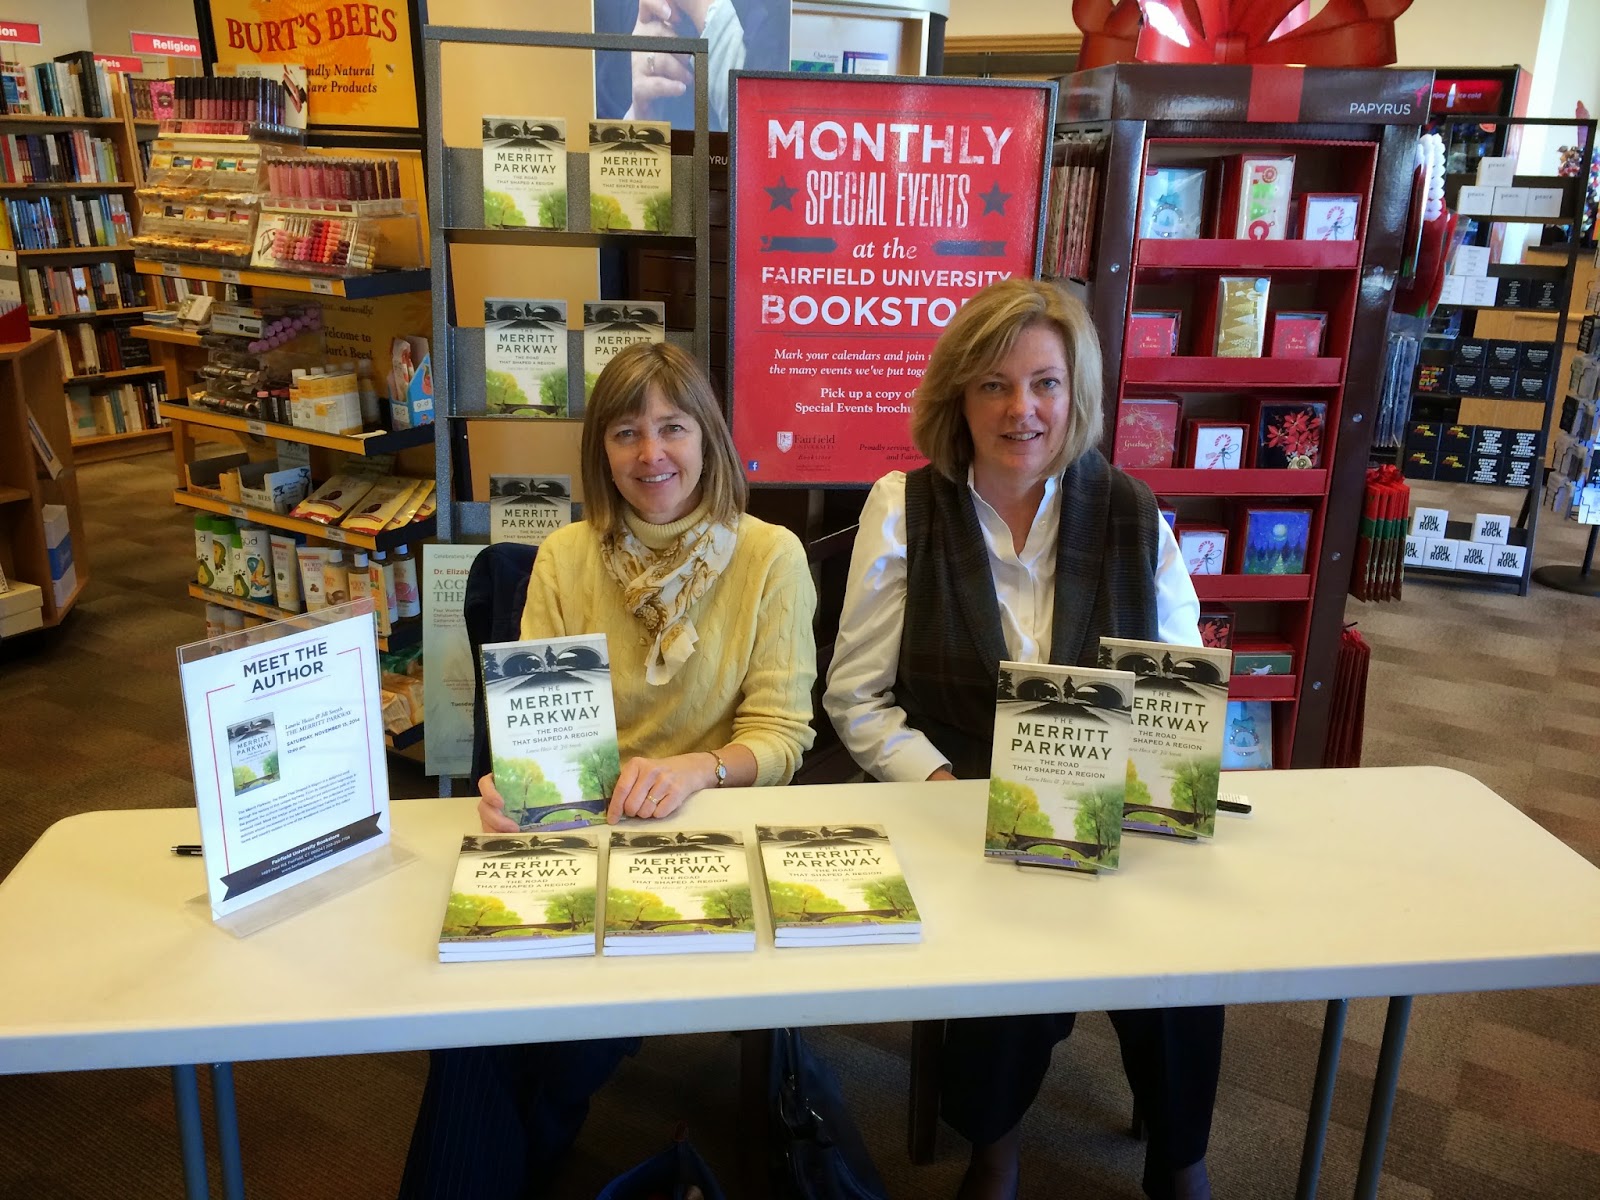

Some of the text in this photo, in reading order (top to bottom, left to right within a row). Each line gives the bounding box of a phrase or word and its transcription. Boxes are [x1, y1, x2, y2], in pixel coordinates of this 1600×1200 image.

[226, 4, 397, 53] BURT'S BEES
[153, 39, 196, 52] Religion
[335, 64, 374, 75] Natural
[331, 81, 377, 92] Products
[1350, 102, 1411, 116] PAPYRUS
[768, 120, 1014, 164] MONTHLY
[497, 153, 553, 163] MERRITT
[604, 156, 658, 166] MERRITT
[710, 156, 728, 165] YRU
[495, 164, 556, 174] PARKWAY
[601, 167, 661, 178] PARKWAY
[805, 170, 970, 228] SPECIAL EVENTS
[853, 238, 916, 259] at the
[762, 267, 1012, 288] FAIRFIELD UNIVERSITY
[361, 333, 371, 342] to
[500, 334, 554, 343] MERRITT
[598, 336, 652, 344] MERRITT
[497, 345, 558, 354] PARKWAY
[774, 349, 924, 364] Mark your calendars and join
[769, 364, 786, 375] the
[789, 367, 817, 377] many
[820, 367, 852, 376] events
[855, 365, 884, 376] we've
[887, 367, 905, 378] put
[820, 388, 844, 399] Pick
[849, 391, 863, 401] up
[875, 391, 901, 401] copy
[904, 388, 916, 398] of
[795, 402, 833, 414] Special
[837, 403, 873, 413] Events
[505, 509, 558, 517] MERRITT
[502, 520, 561, 528] PARKWAY
[1424, 515, 1438, 523] YOU
[1485, 521, 1500, 530] YOU
[1406, 542, 1416, 550] OU
[1434, 545, 1449, 554] YOU
[1468, 548, 1482, 557] YOU
[1501, 551, 1516, 560] YOU
[433, 579, 464, 590] ACC
[243, 641, 328, 677] MEET THE
[251, 660, 324, 693] AUTHOR
[510, 690, 594, 711] MERRITT
[1133, 697, 1206, 716] ERRITT
[299, 719, 325, 732] MERRITT
[326, 710, 352, 723] PARKWAY
[507, 705, 600, 728] PARKWAY
[553, 725, 573, 733] ROAD
[1131, 714, 1209, 734] RKWAY
[314, 724, 341, 737] NOVEMBER
[1017, 722, 1109, 743] MERRITT
[1155, 732, 1177, 740] ROAD
[238, 734, 269, 749] MERRITT
[533, 735, 563, 744] SHAPED
[571, 731, 599, 739] REGION
[236, 740, 272, 756] PARKWAY
[1133, 737, 1164, 746] SHAPED
[1173, 742, 1202, 750] REGION
[1011, 739, 1113, 761] PARKWAY
[1040, 759, 1055, 767] THE
[1034, 766, 1066, 776] SHAPED
[1075, 771, 1106, 779] REGION
[785, 848, 874, 859] MERRITT
[482, 859, 577, 870] MERRITT
[634, 856, 726, 865] MERRITT
[783, 857, 882, 867] PARKWAY
[475, 868, 582, 879] PARKWAY
[628, 864, 731, 875] PARKWAY
